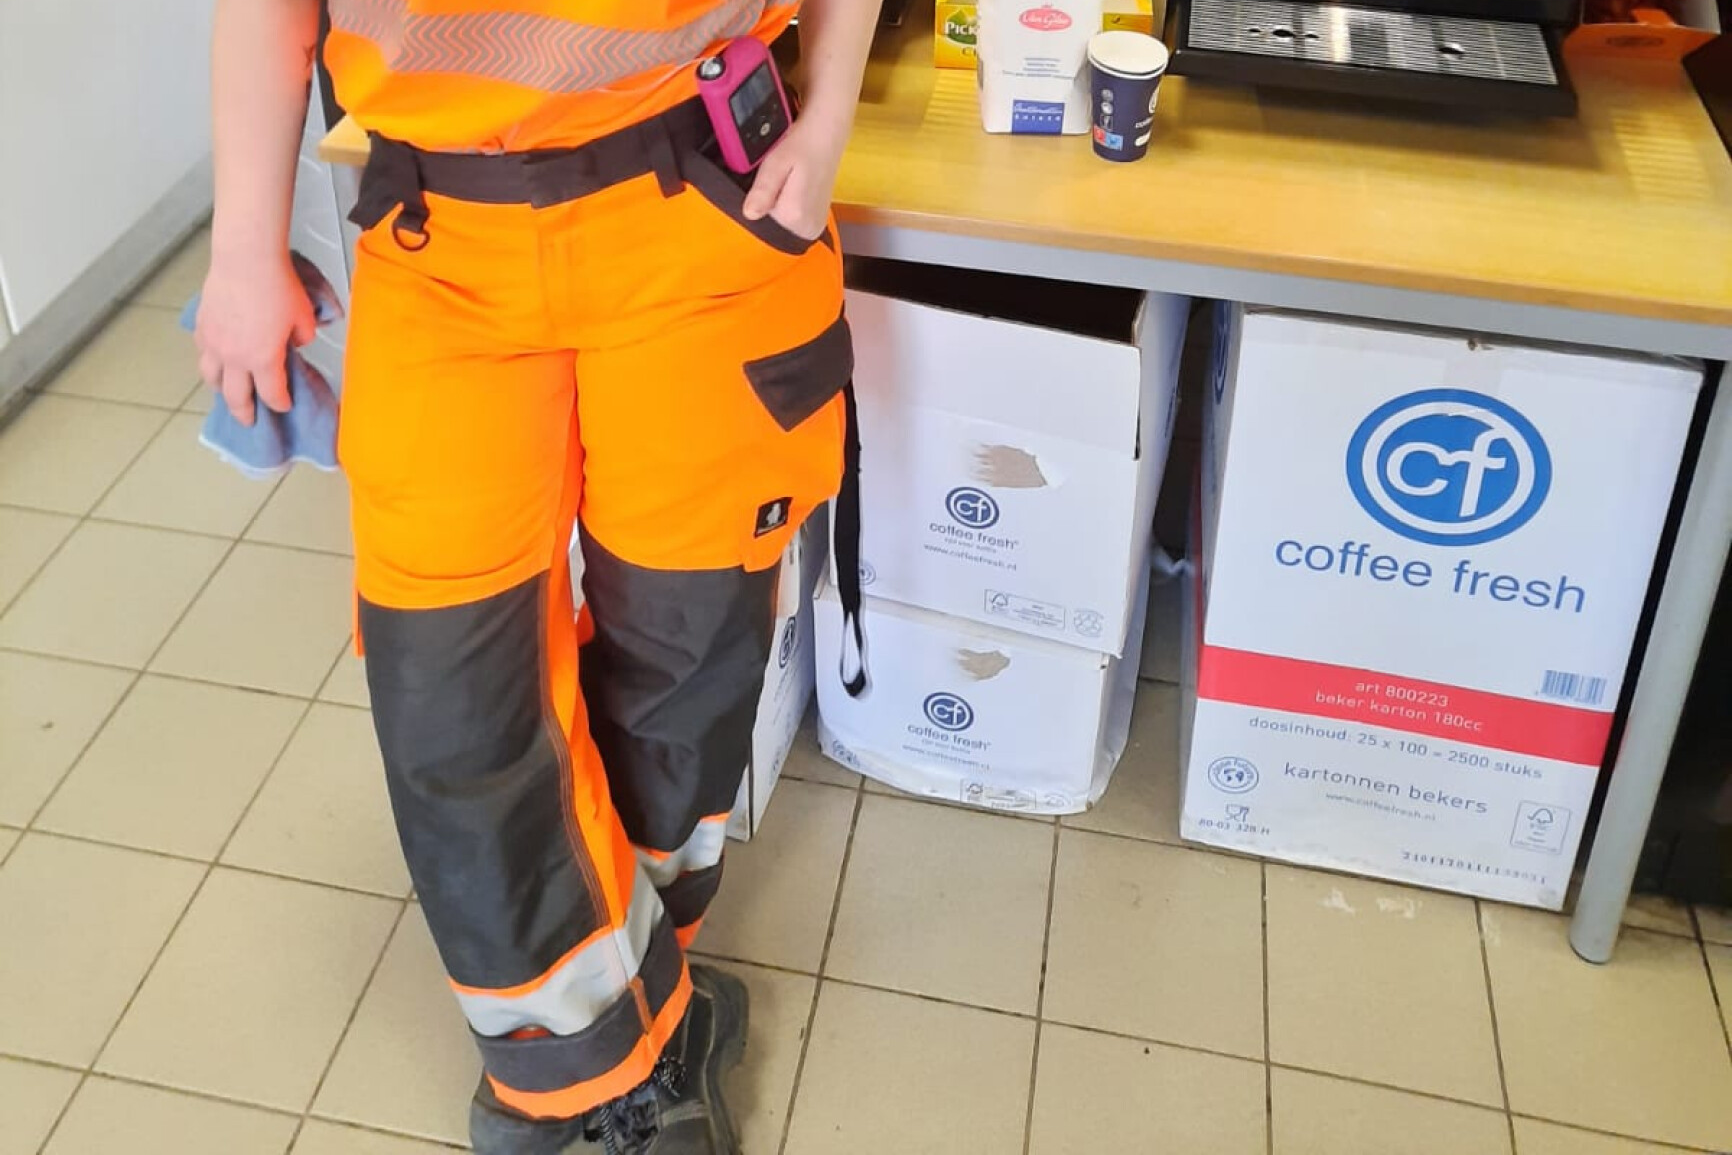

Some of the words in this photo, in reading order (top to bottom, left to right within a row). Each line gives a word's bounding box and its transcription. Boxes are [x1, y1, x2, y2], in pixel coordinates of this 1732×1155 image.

[1386, 428, 1506, 517] cf
[929, 522, 973, 541] coffee
[1274, 540, 1433, 587] coffee
[1452, 559, 1586, 613] fresh
[1314, 691, 1363, 709] beker
[1369, 701, 1428, 721] karton
[1433, 711, 1484, 732] 180cc
[1354, 680, 1380, 694] art
[1385, 685, 1450, 708] 800223
[907, 724, 949, 741] coffee
[1249, 715, 1352, 742] doosinhoud:
[1357, 733, 1377, 746] 25
[1381, 740, 1391, 750] x
[1399, 741, 1428, 756] 100
[1448, 750, 1489, 768] 2500
[1494, 760, 1542, 779] stuks
[1284, 761, 1400, 796] kartonnen
[1408, 784, 1488, 814] bekers
